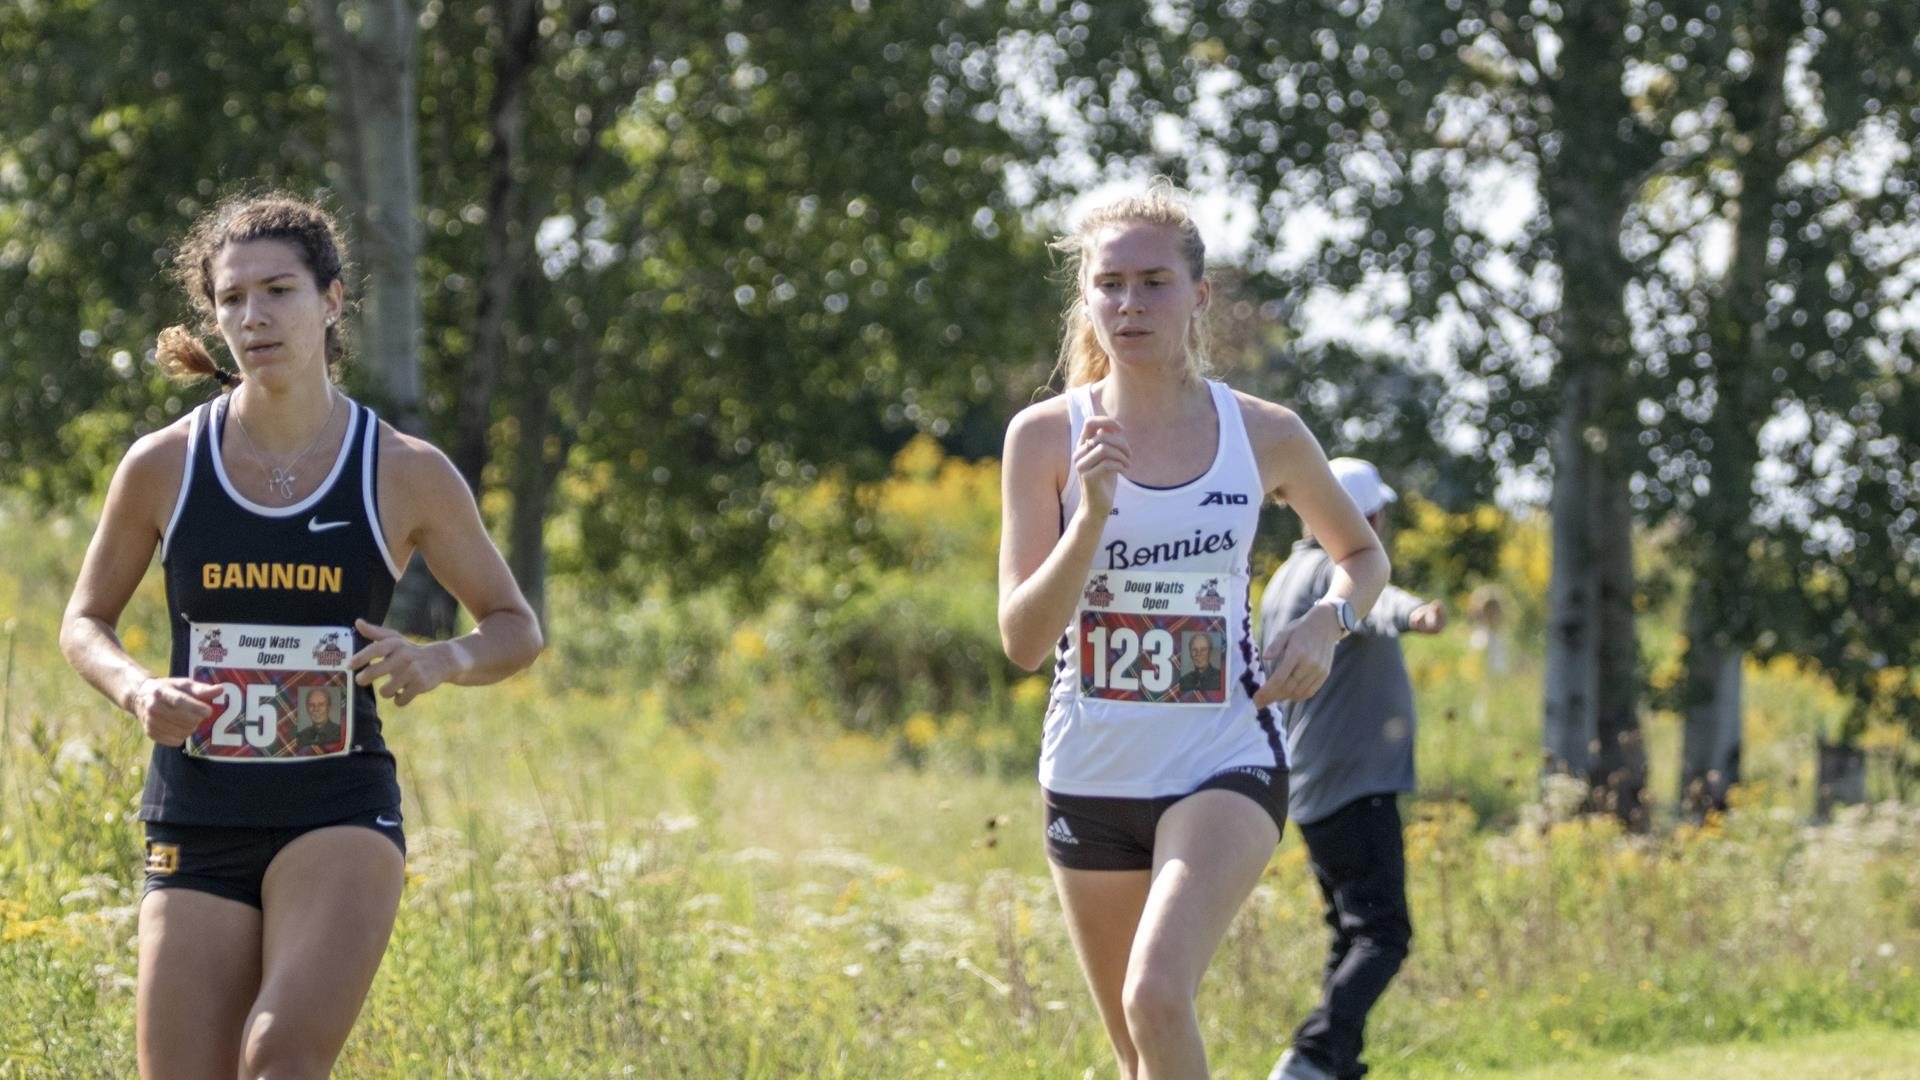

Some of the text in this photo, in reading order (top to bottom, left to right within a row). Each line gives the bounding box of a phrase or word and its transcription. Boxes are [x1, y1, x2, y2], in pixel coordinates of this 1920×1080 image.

[1105, 529, 1237, 570] Bonnies
[202, 563, 342, 593] GANNON
[1124, 580, 1185, 595] Doug Watts
[1142, 597, 1169, 611] Open
[238, 634, 301, 650] Doug Watts
[257, 651, 285, 665] Open
[1087, 626, 1174, 693] 123
[211, 682, 277, 748] 25
